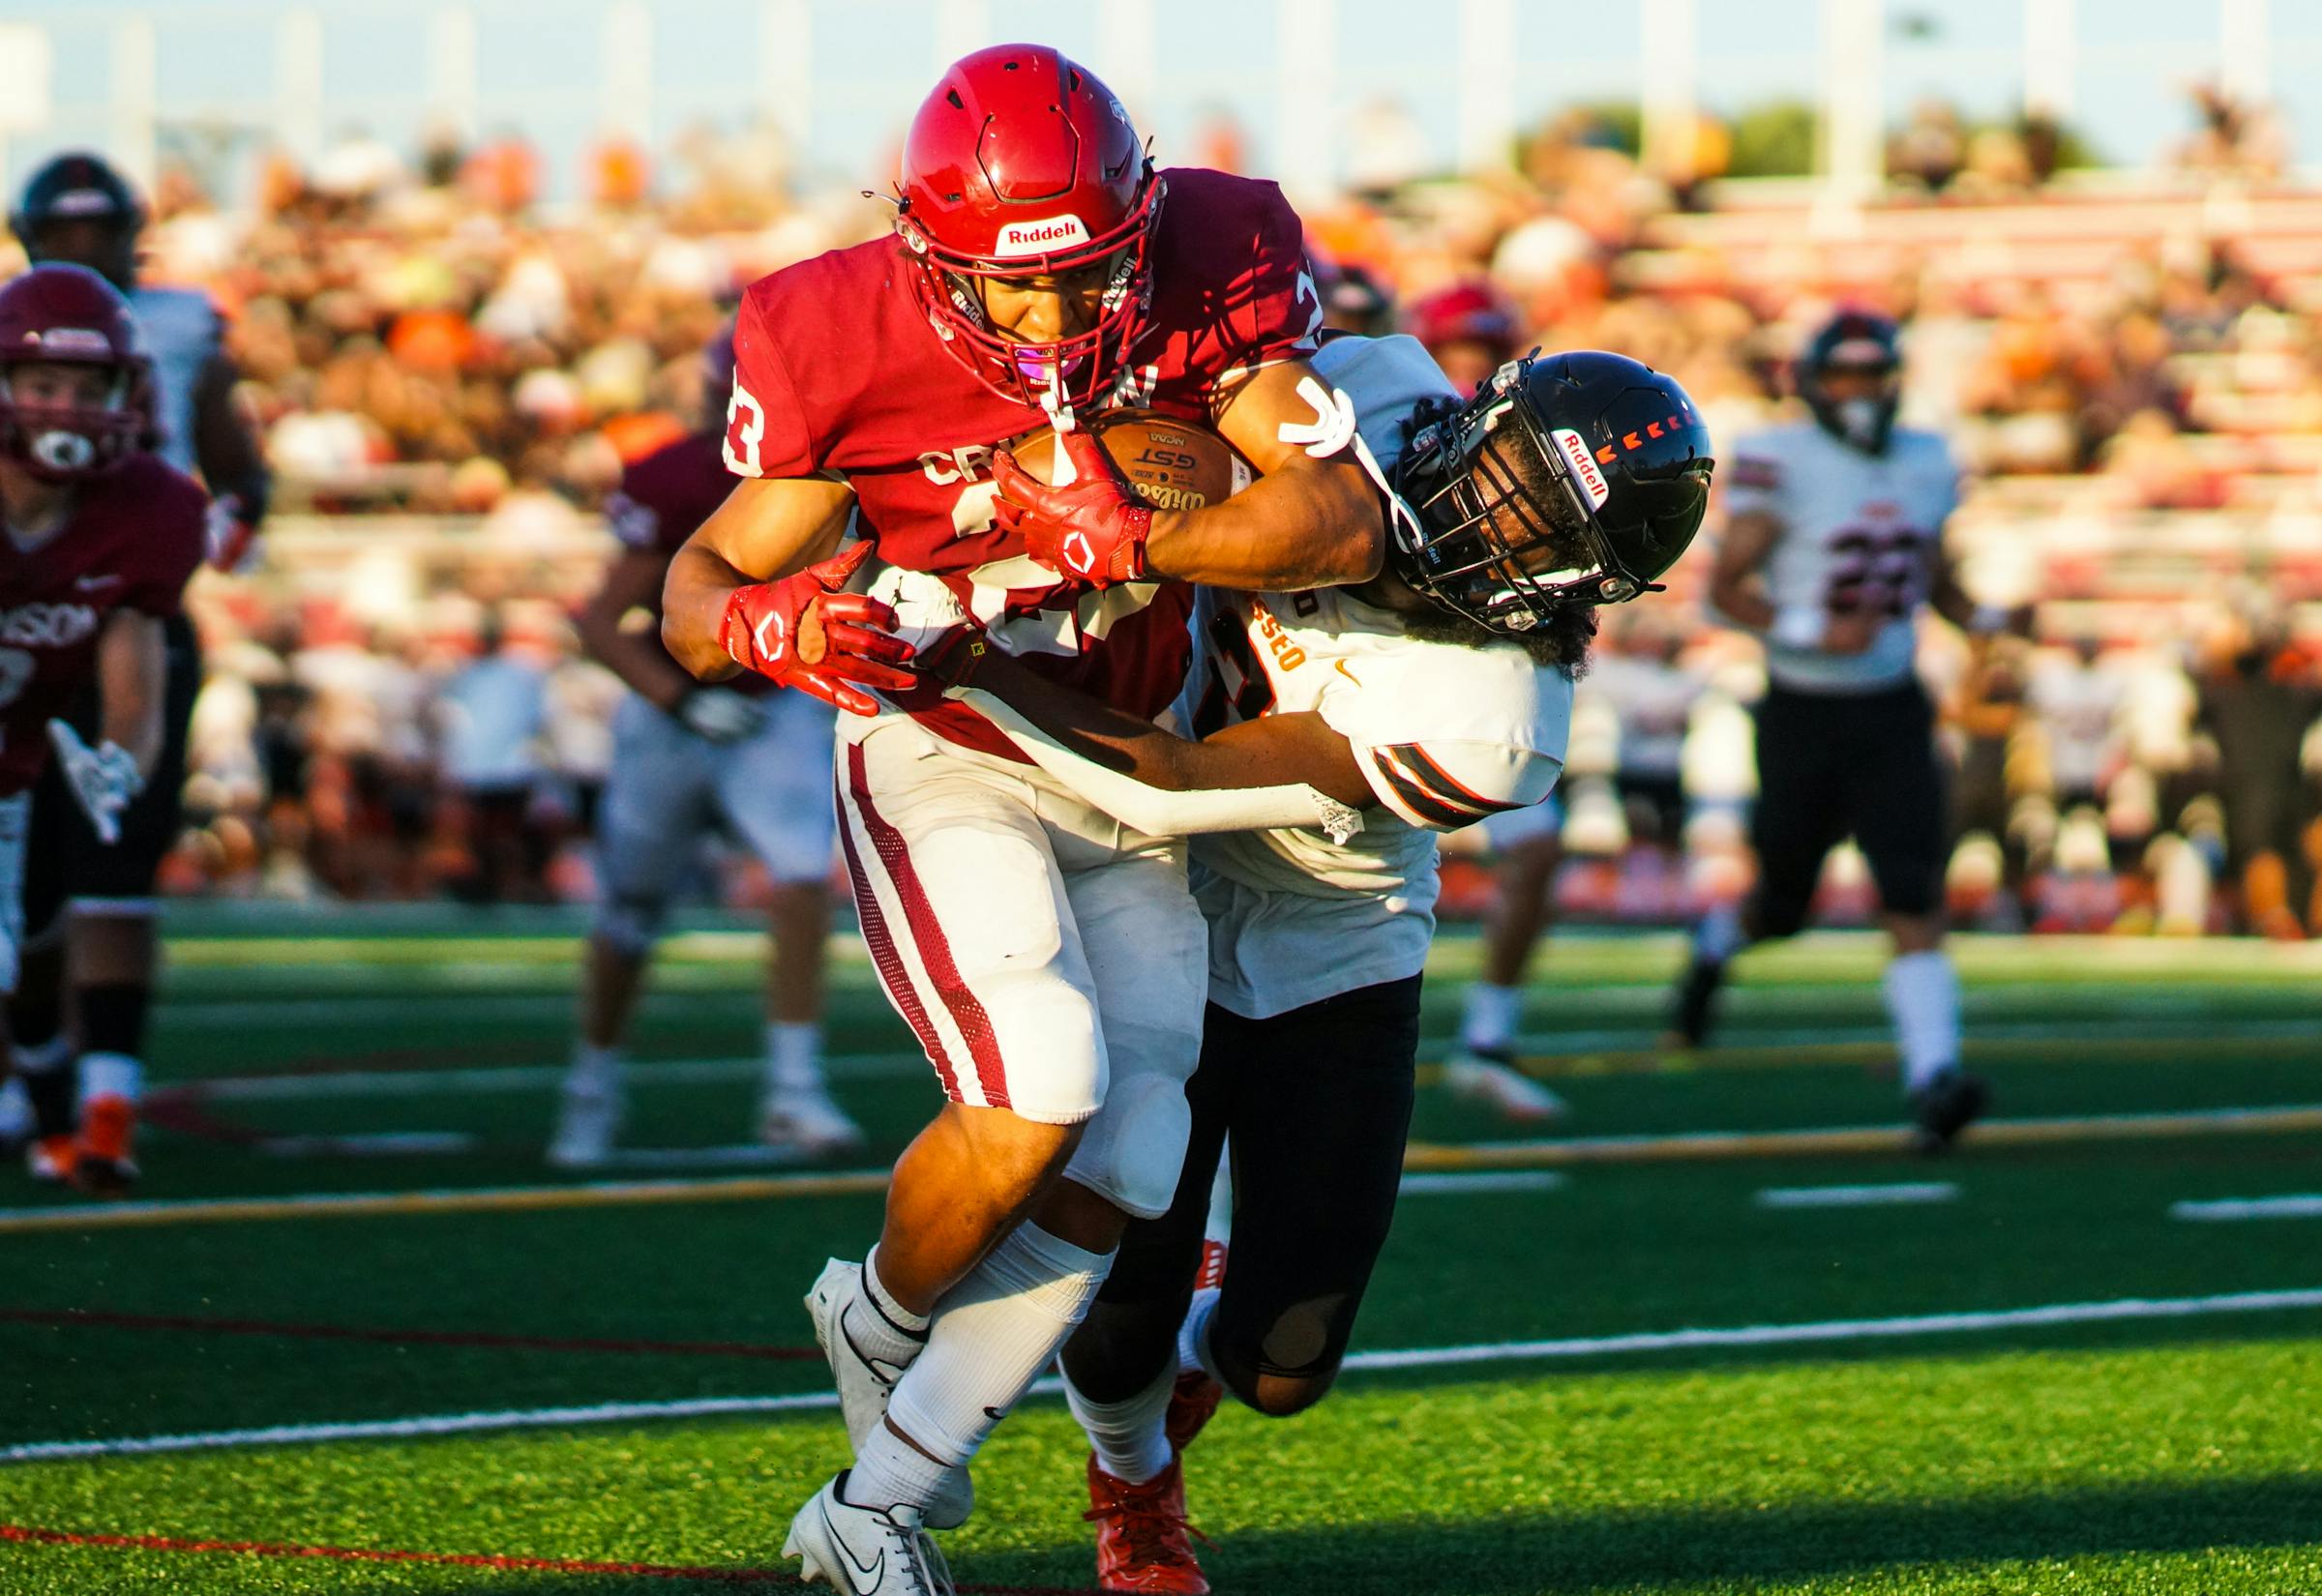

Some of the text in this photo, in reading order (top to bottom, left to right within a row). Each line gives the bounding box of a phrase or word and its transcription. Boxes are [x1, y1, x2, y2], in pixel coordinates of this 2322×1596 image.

[1008, 222, 1077, 245] Riddell
[950, 290, 985, 331] Ridde
[1148, 431, 1185, 448] NCAA
[1133, 448, 1197, 470] GST
[1564, 434, 1607, 497] Riddell
[1133, 482, 1206, 512] Wilso
[1422, 532, 1441, 565] Ridell
